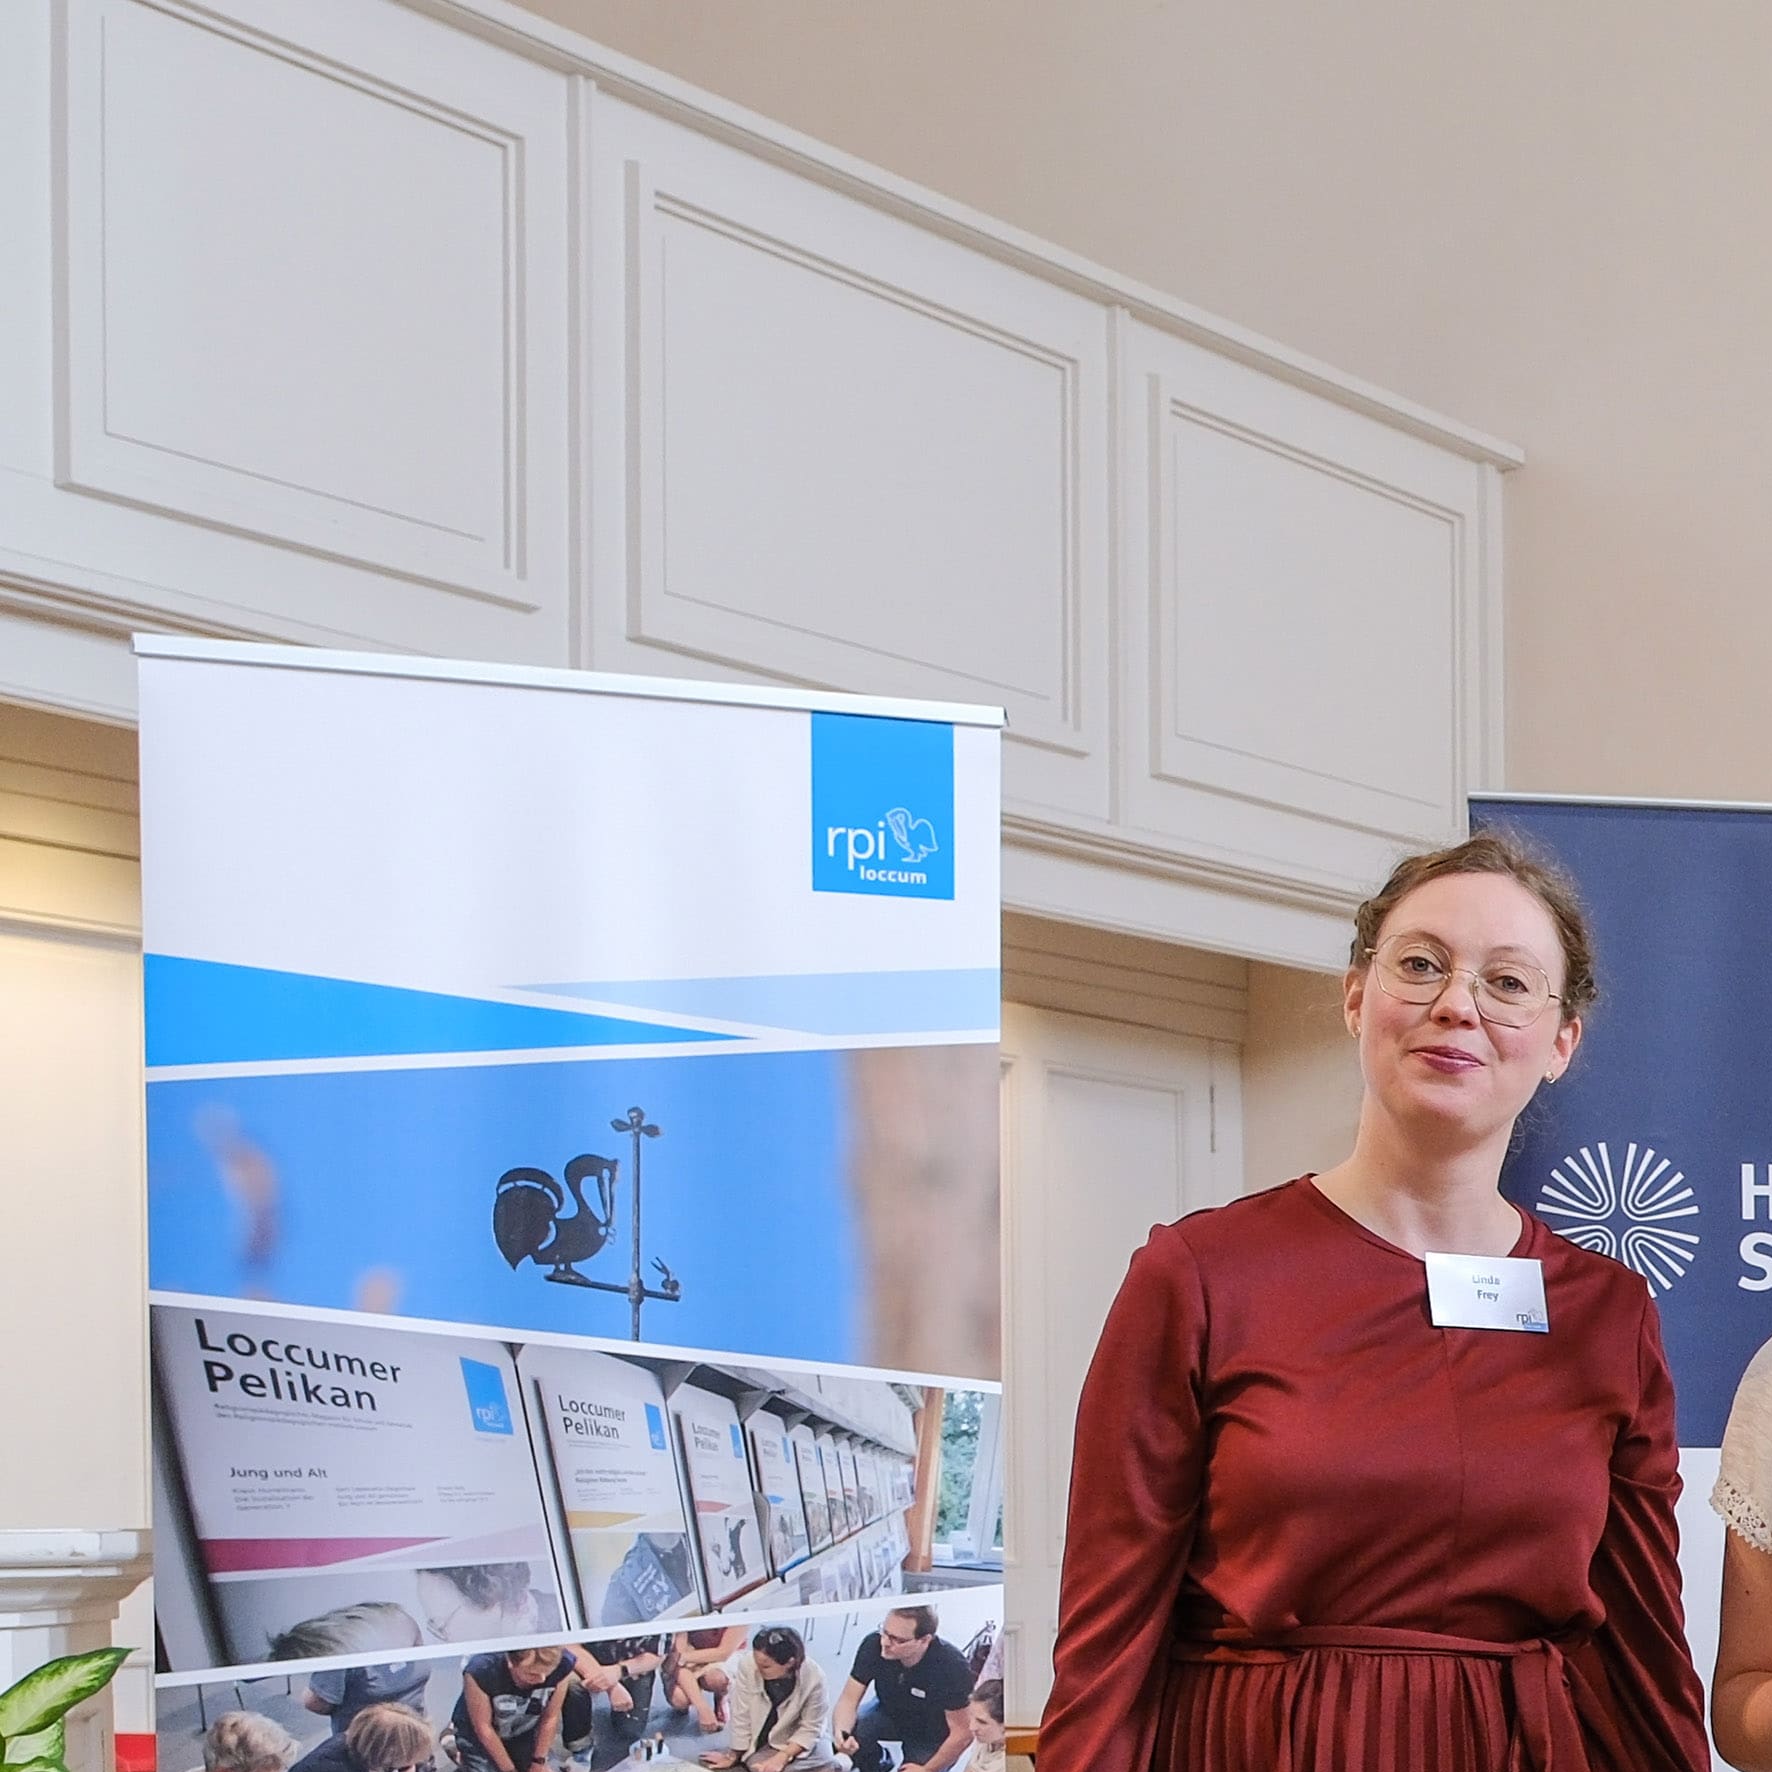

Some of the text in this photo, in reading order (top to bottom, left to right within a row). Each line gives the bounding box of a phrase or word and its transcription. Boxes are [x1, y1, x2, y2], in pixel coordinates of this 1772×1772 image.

[827, 820, 885, 870] rpi
[860, 865, 927, 884] loccum
[1472, 1275, 1501, 1286] Linda
[1477, 1289, 1499, 1302] Frey
[194, 1318, 402, 1384] Loccumer
[203, 1359, 378, 1412] Pelikan
[558, 1394, 626, 1422] Loccumer
[563, 1416, 620, 1440] Pelikan
[230, 1466, 328, 1480] Jung und Alt
